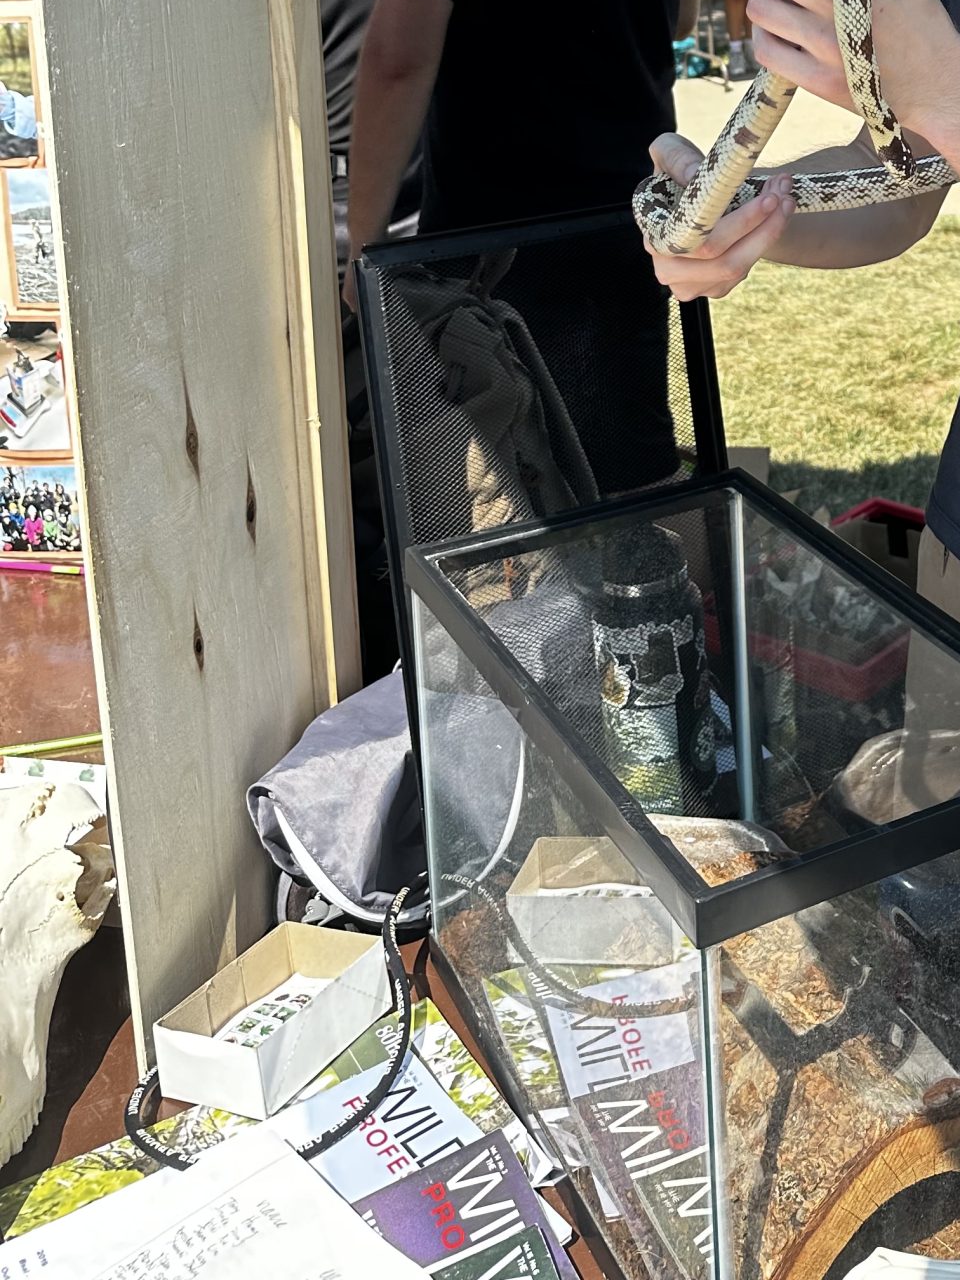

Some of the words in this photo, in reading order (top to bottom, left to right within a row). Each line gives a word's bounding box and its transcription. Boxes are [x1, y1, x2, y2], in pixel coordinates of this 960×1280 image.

[391, 887, 410, 914] UNDER
[127, 1086, 145, 1116] UNDER
[421, 1182, 465, 1250] PRO
